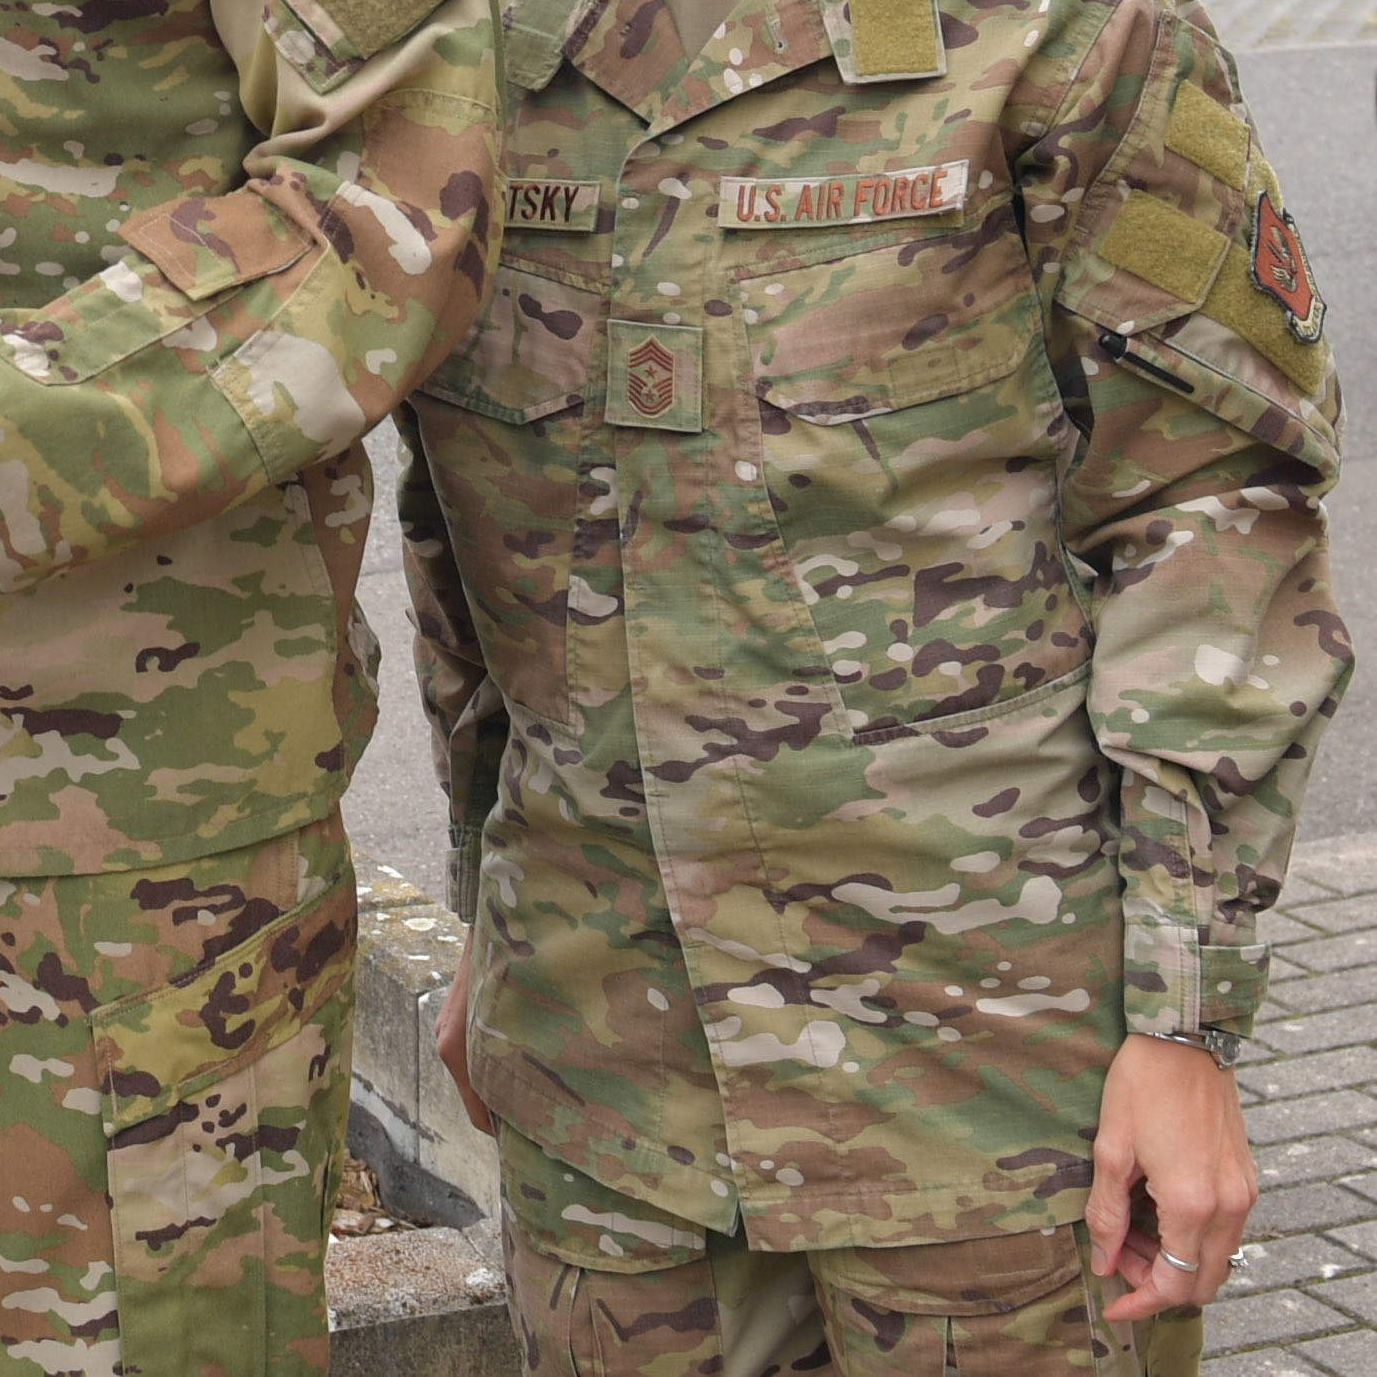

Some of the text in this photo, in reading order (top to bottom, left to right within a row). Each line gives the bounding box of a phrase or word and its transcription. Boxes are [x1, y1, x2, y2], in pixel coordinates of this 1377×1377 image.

[736, 170, 948, 222] U.S. AIR FORCE
